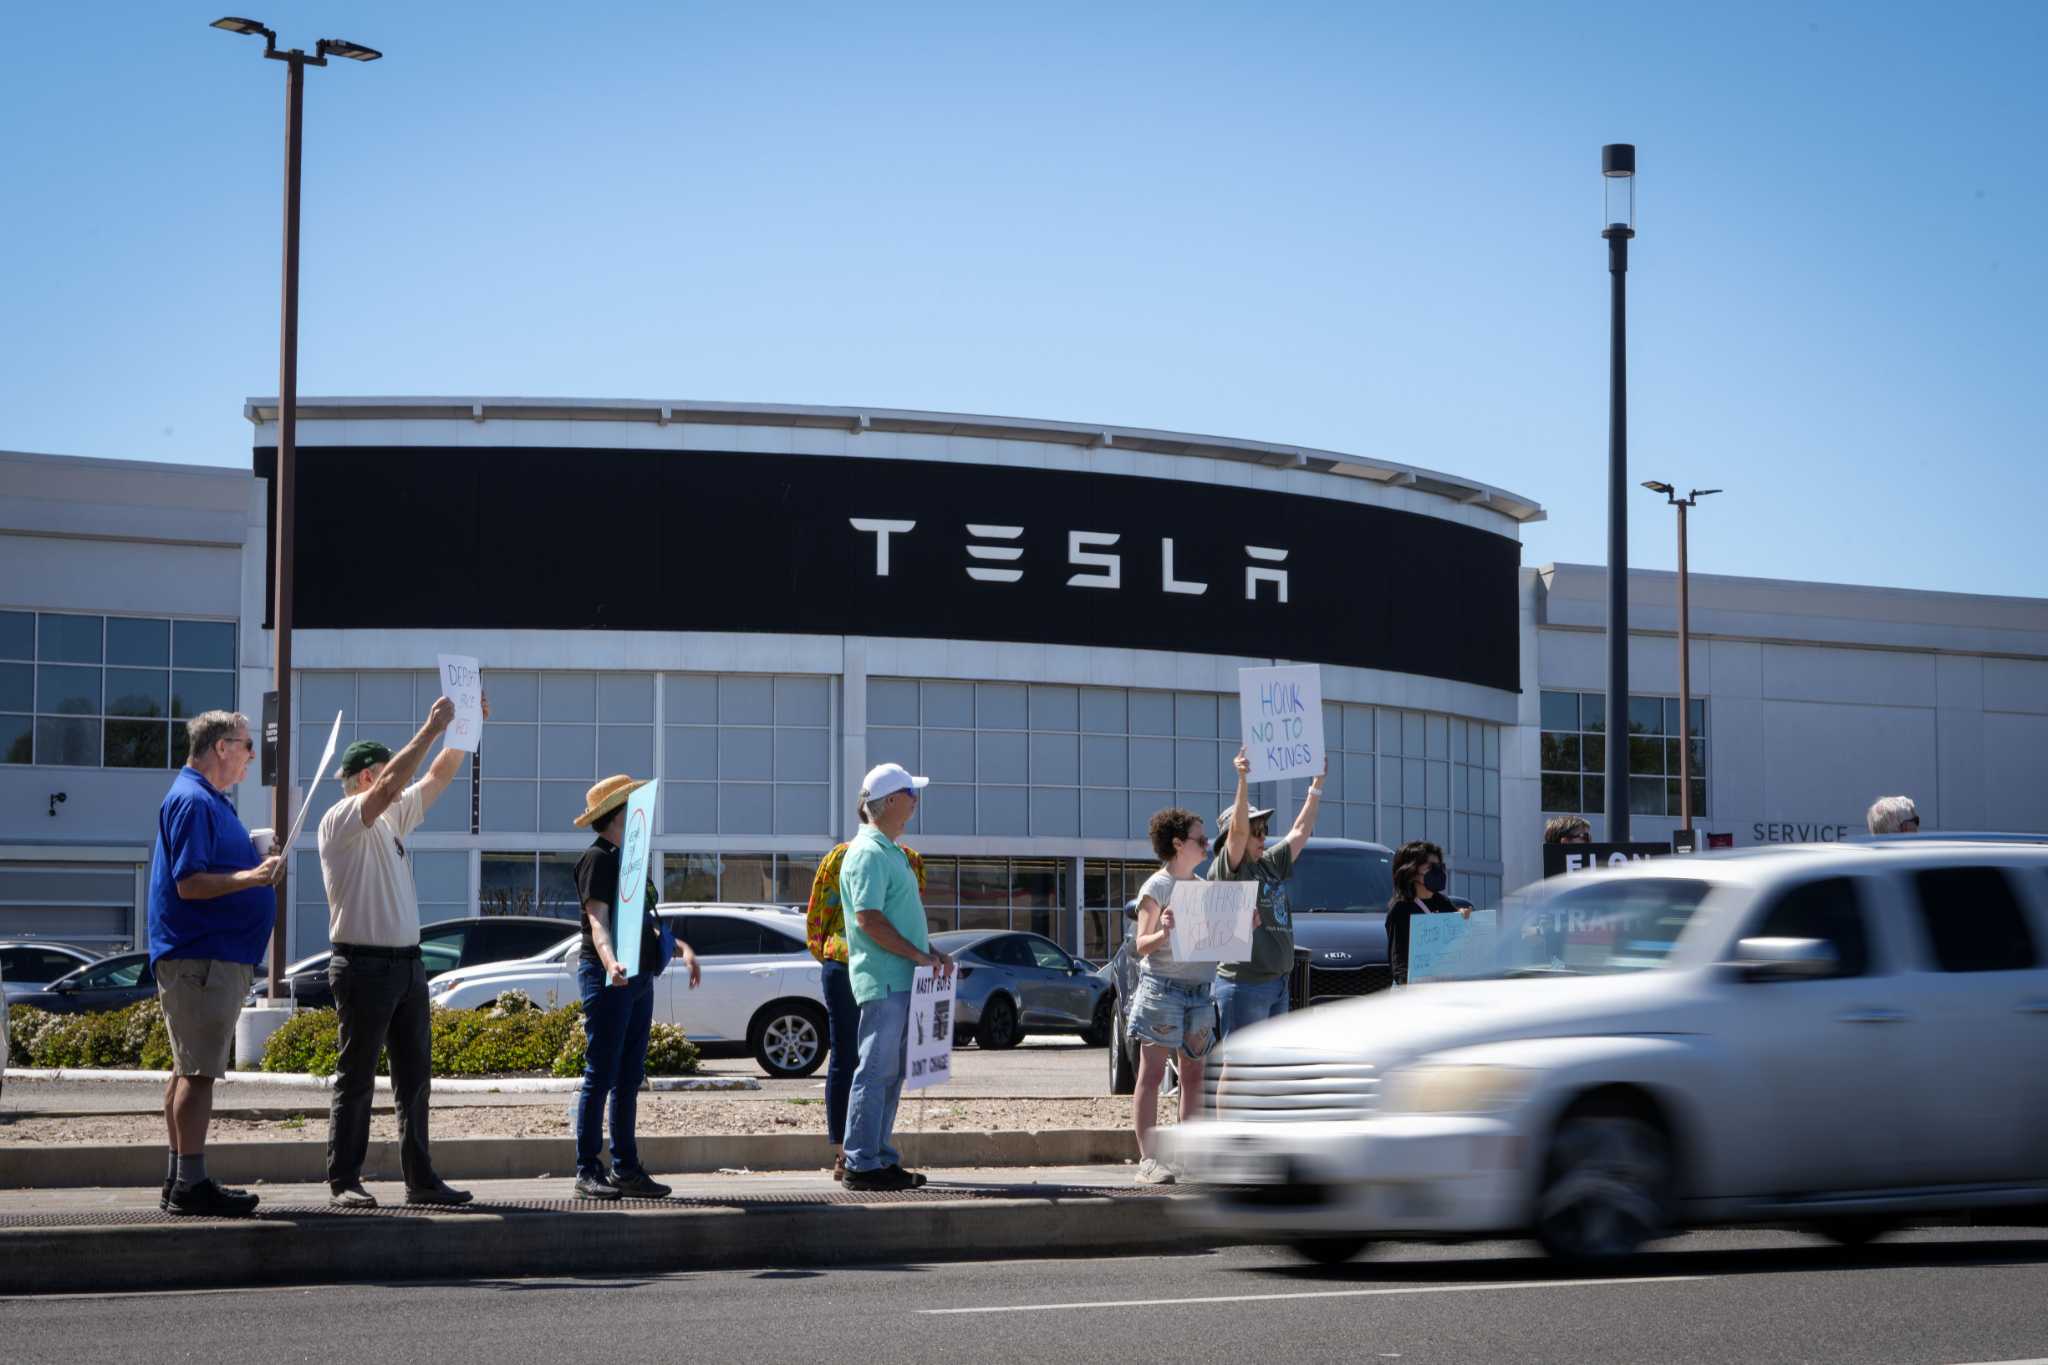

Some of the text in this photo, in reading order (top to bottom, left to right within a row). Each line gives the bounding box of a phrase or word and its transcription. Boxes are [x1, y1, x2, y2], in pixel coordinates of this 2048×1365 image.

[849, 517, 1289, 603] TESLA
[1261, 680, 1304, 716] HONK
[1251, 716, 1303, 744] NO TO
[1266, 743, 1312, 771] KINGS
[1753, 823, 1849, 843] SERVICE
